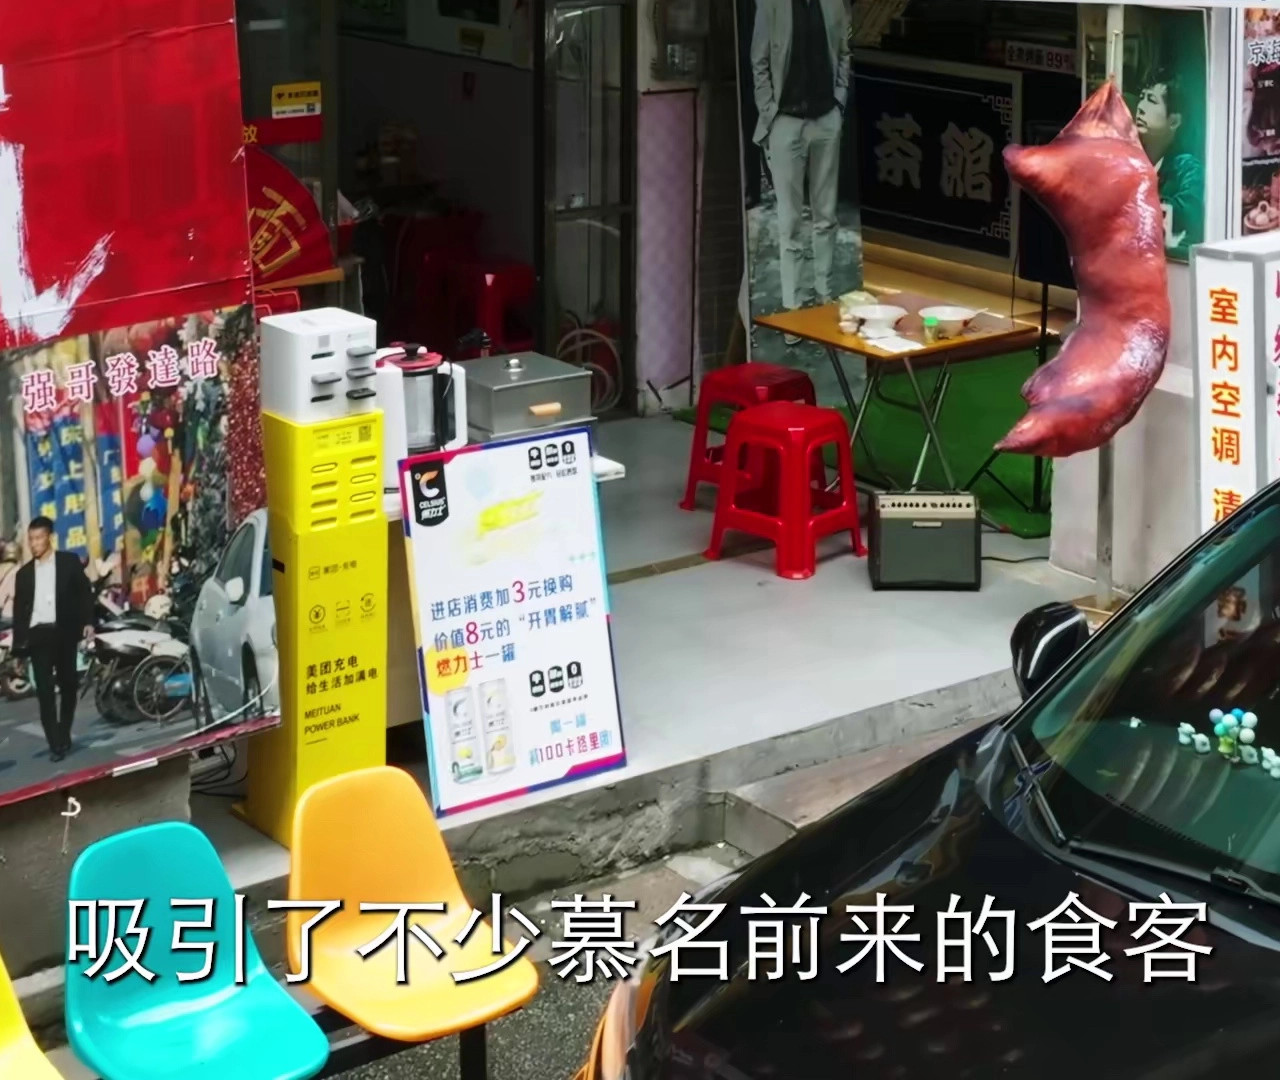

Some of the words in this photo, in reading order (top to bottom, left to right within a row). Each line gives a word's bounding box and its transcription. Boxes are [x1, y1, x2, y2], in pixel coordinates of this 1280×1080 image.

[1208, 288, 1243, 467] 室内空调
[431, 574, 574, 623] 进店消费加3元换购
[306, 655, 359, 680] 美团充电
[436, 642, 516, 678] 燃力士一罐
[304, 703, 342, 720] MEITUAN
[304, 718, 335, 735] POWER
[336, 712, 361, 727] BANK
